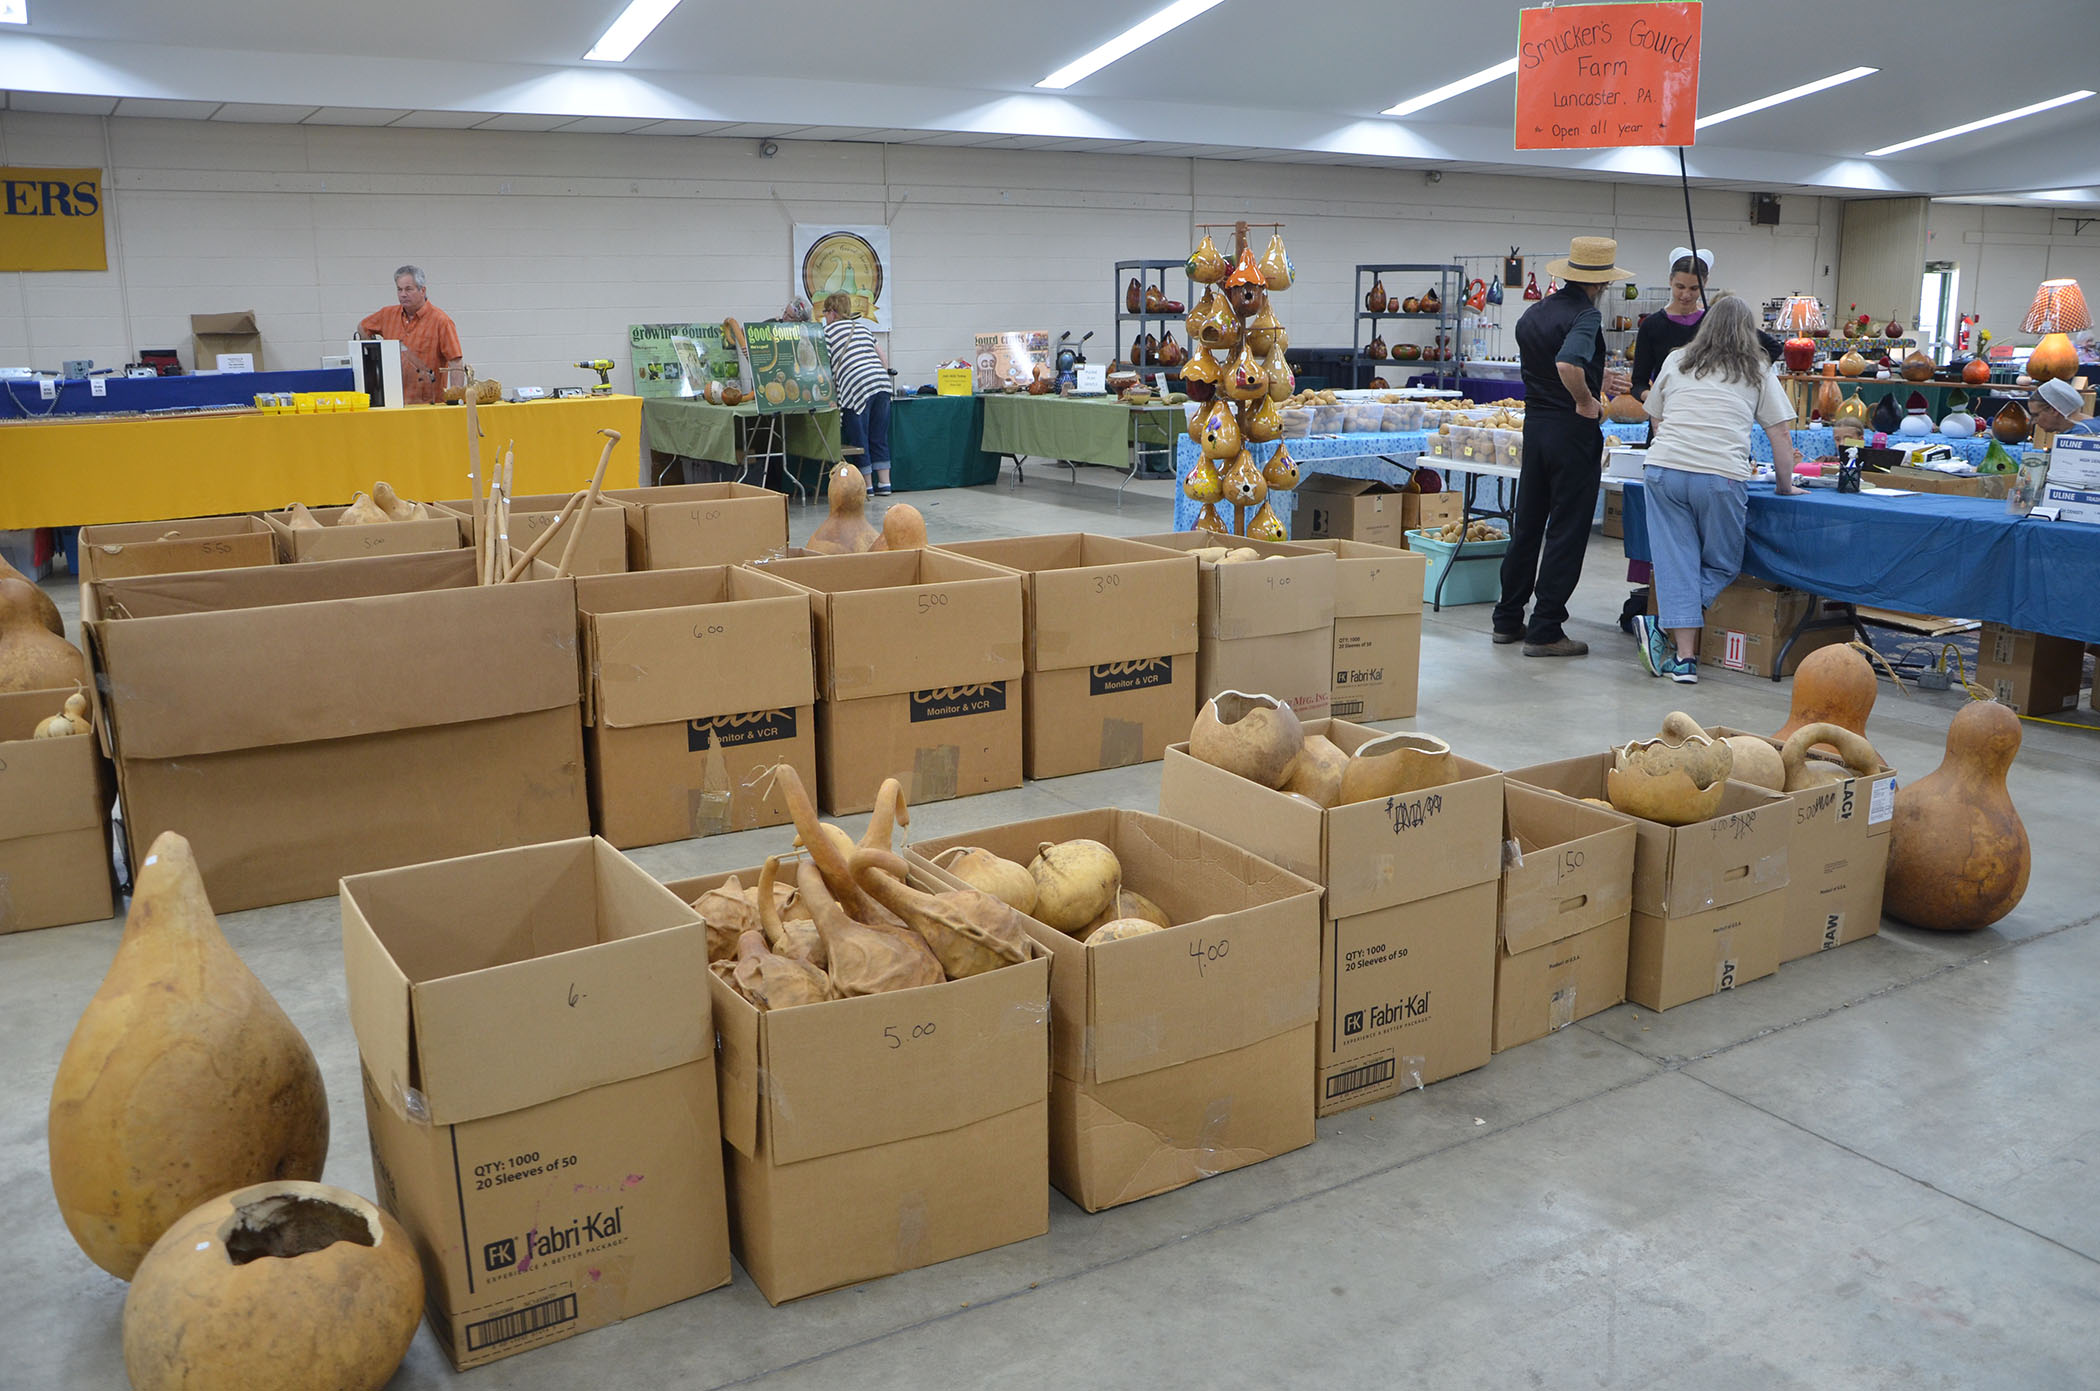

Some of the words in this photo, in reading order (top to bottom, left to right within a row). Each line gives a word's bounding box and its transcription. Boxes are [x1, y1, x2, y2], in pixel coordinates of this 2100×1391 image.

[1522, 21, 1612, 69] Smucker's
[1629, 19, 1692, 62] Gourd
[1578, 55, 1628, 77] Farm
[1552, 124, 1580, 141] Open
[1590, 120, 1607, 135] all
[1618, 123, 1643, 137] year
[2, 180, 99, 216] ERS
[632, 326, 678, 342] growing
[682, 326, 720, 340] gourds
[748, 325, 772, 344] good
[2060, 440, 2083, 449] ULINE
[2053, 491, 2076, 501] ULINE
[1104, 679, 1134, 690] Monitor
[1142, 674, 1159, 684] VCR
[927, 705, 960, 716] Monitor
[962, 703, 969, 712] &
[971, 700, 990, 710] VCR
[707, 732, 745, 746] onitor
[747, 731, 755, 740] &
[757, 727, 779, 737] VCR
[1345, 949, 1365, 961] QTY:
[1367, 944, 1386, 955] 1000
[1345, 963, 1356, 972] 20
[1357, 956, 1387, 969] Sleeves
[1388, 952, 1397, 960] of
[1397, 948, 1408, 958] 50
[1345, 1012, 1363, 1035] FK
[474, 1160, 505, 1177] QTY:
[508, 1152, 540, 1168] 1000
[476, 1178, 493, 1191] 20
[496, 1166, 543, 1186] Sleeves
[546, 1159, 559, 1172] of
[562, 1155, 578, 1168] 50
[485, 1240, 515, 1270] FK
[551, 1251, 583, 1265] BETTER
